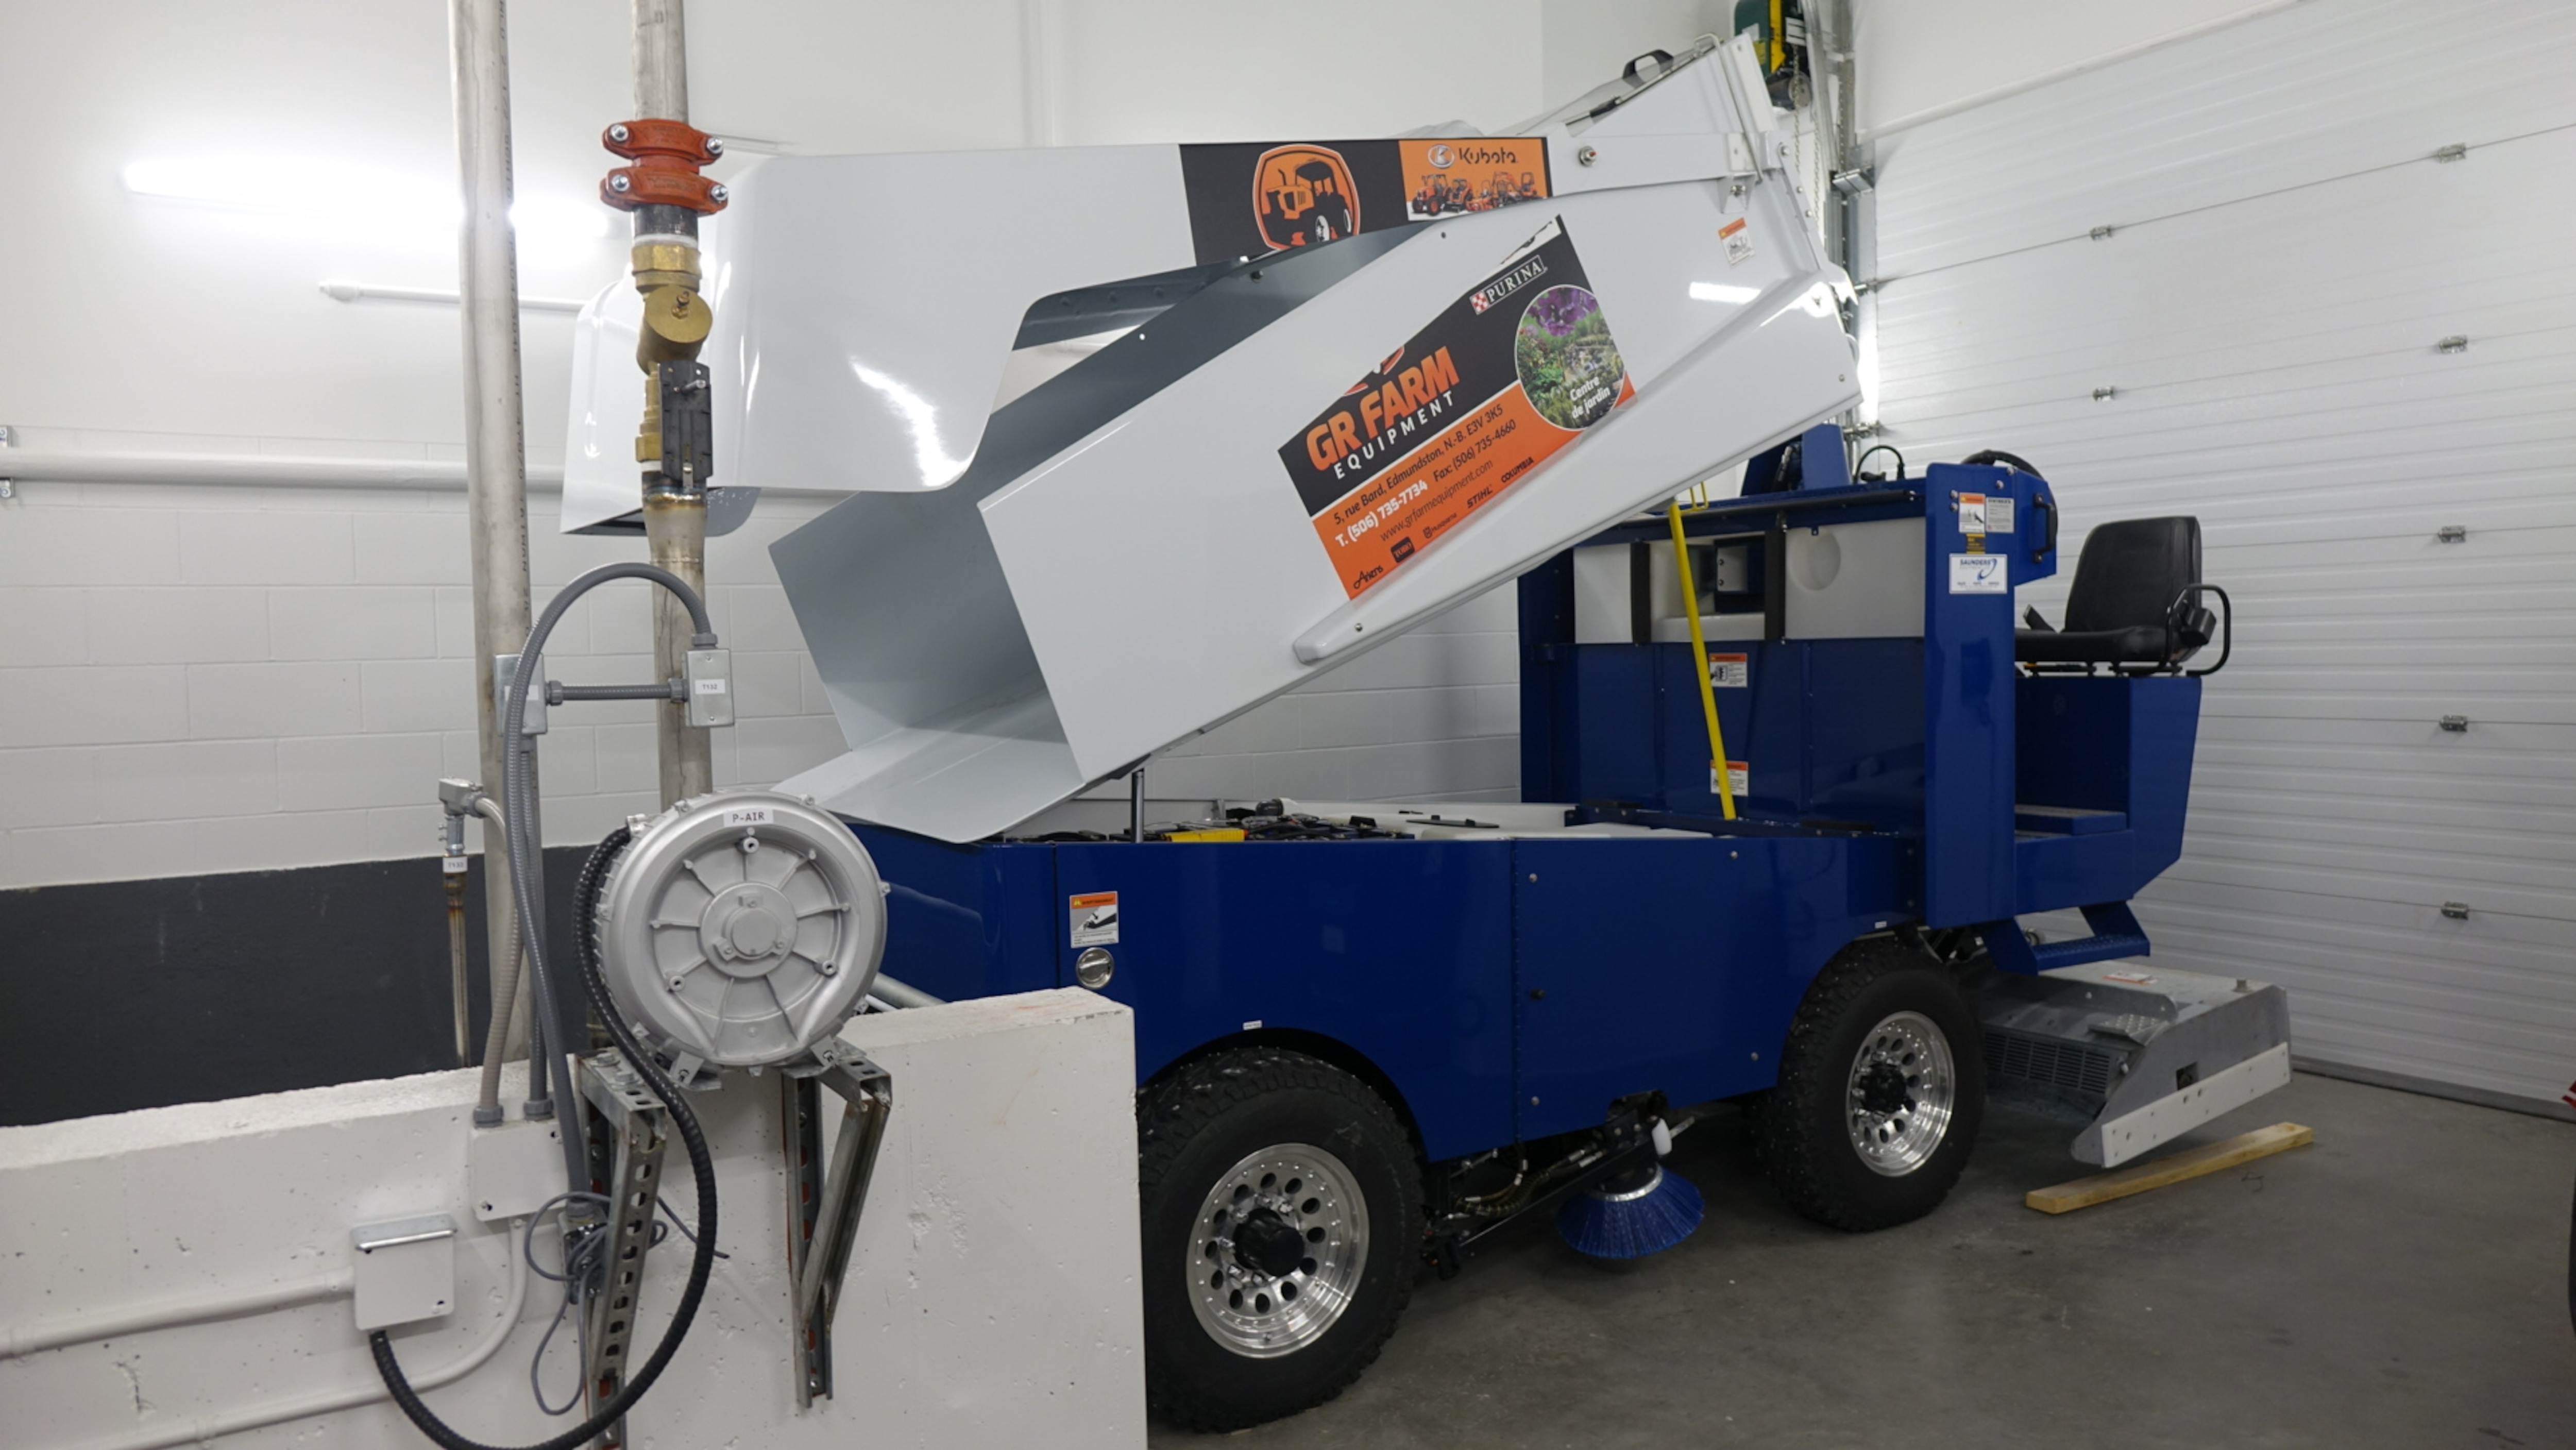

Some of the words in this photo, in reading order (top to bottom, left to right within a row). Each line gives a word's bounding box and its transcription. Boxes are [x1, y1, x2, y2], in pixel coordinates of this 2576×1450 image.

[1458, 146, 1516, 164] Kubota
[1486, 261, 1541, 302] PURINA
[1307, 411, 1362, 471] GR
[1359, 346, 1460, 440] FARM
[1570, 376, 1600, 401] Centre
[1571, 404, 1584, 418] de
[1583, 387, 1611, 414] jardin
[1333, 391, 1453, 479] EQUIPMENT
[1345, 502, 1361, 518] rue
[1361, 483, 1387, 507] Bard,
[1386, 446, 1445, 489] Edmundston,
[1466, 416, 1484, 436] E3V
[1484, 403, 1503, 424] 3K5
[1335, 533, 1349, 547] T.
[1347, 511, 1379, 542] (506)
[1377, 479, 1428, 519] 735-7734
[1433, 465, 1453, 482] Fax:
[1452, 446, 1476, 470] (506)
[1475, 418, 1516, 454] 735-4660
[1380, 460, 1494, 542] www.grfarmequipment.com
[1467, 485, 1493, 509] STIHL
[732, 812, 765, 823] P-AIR
